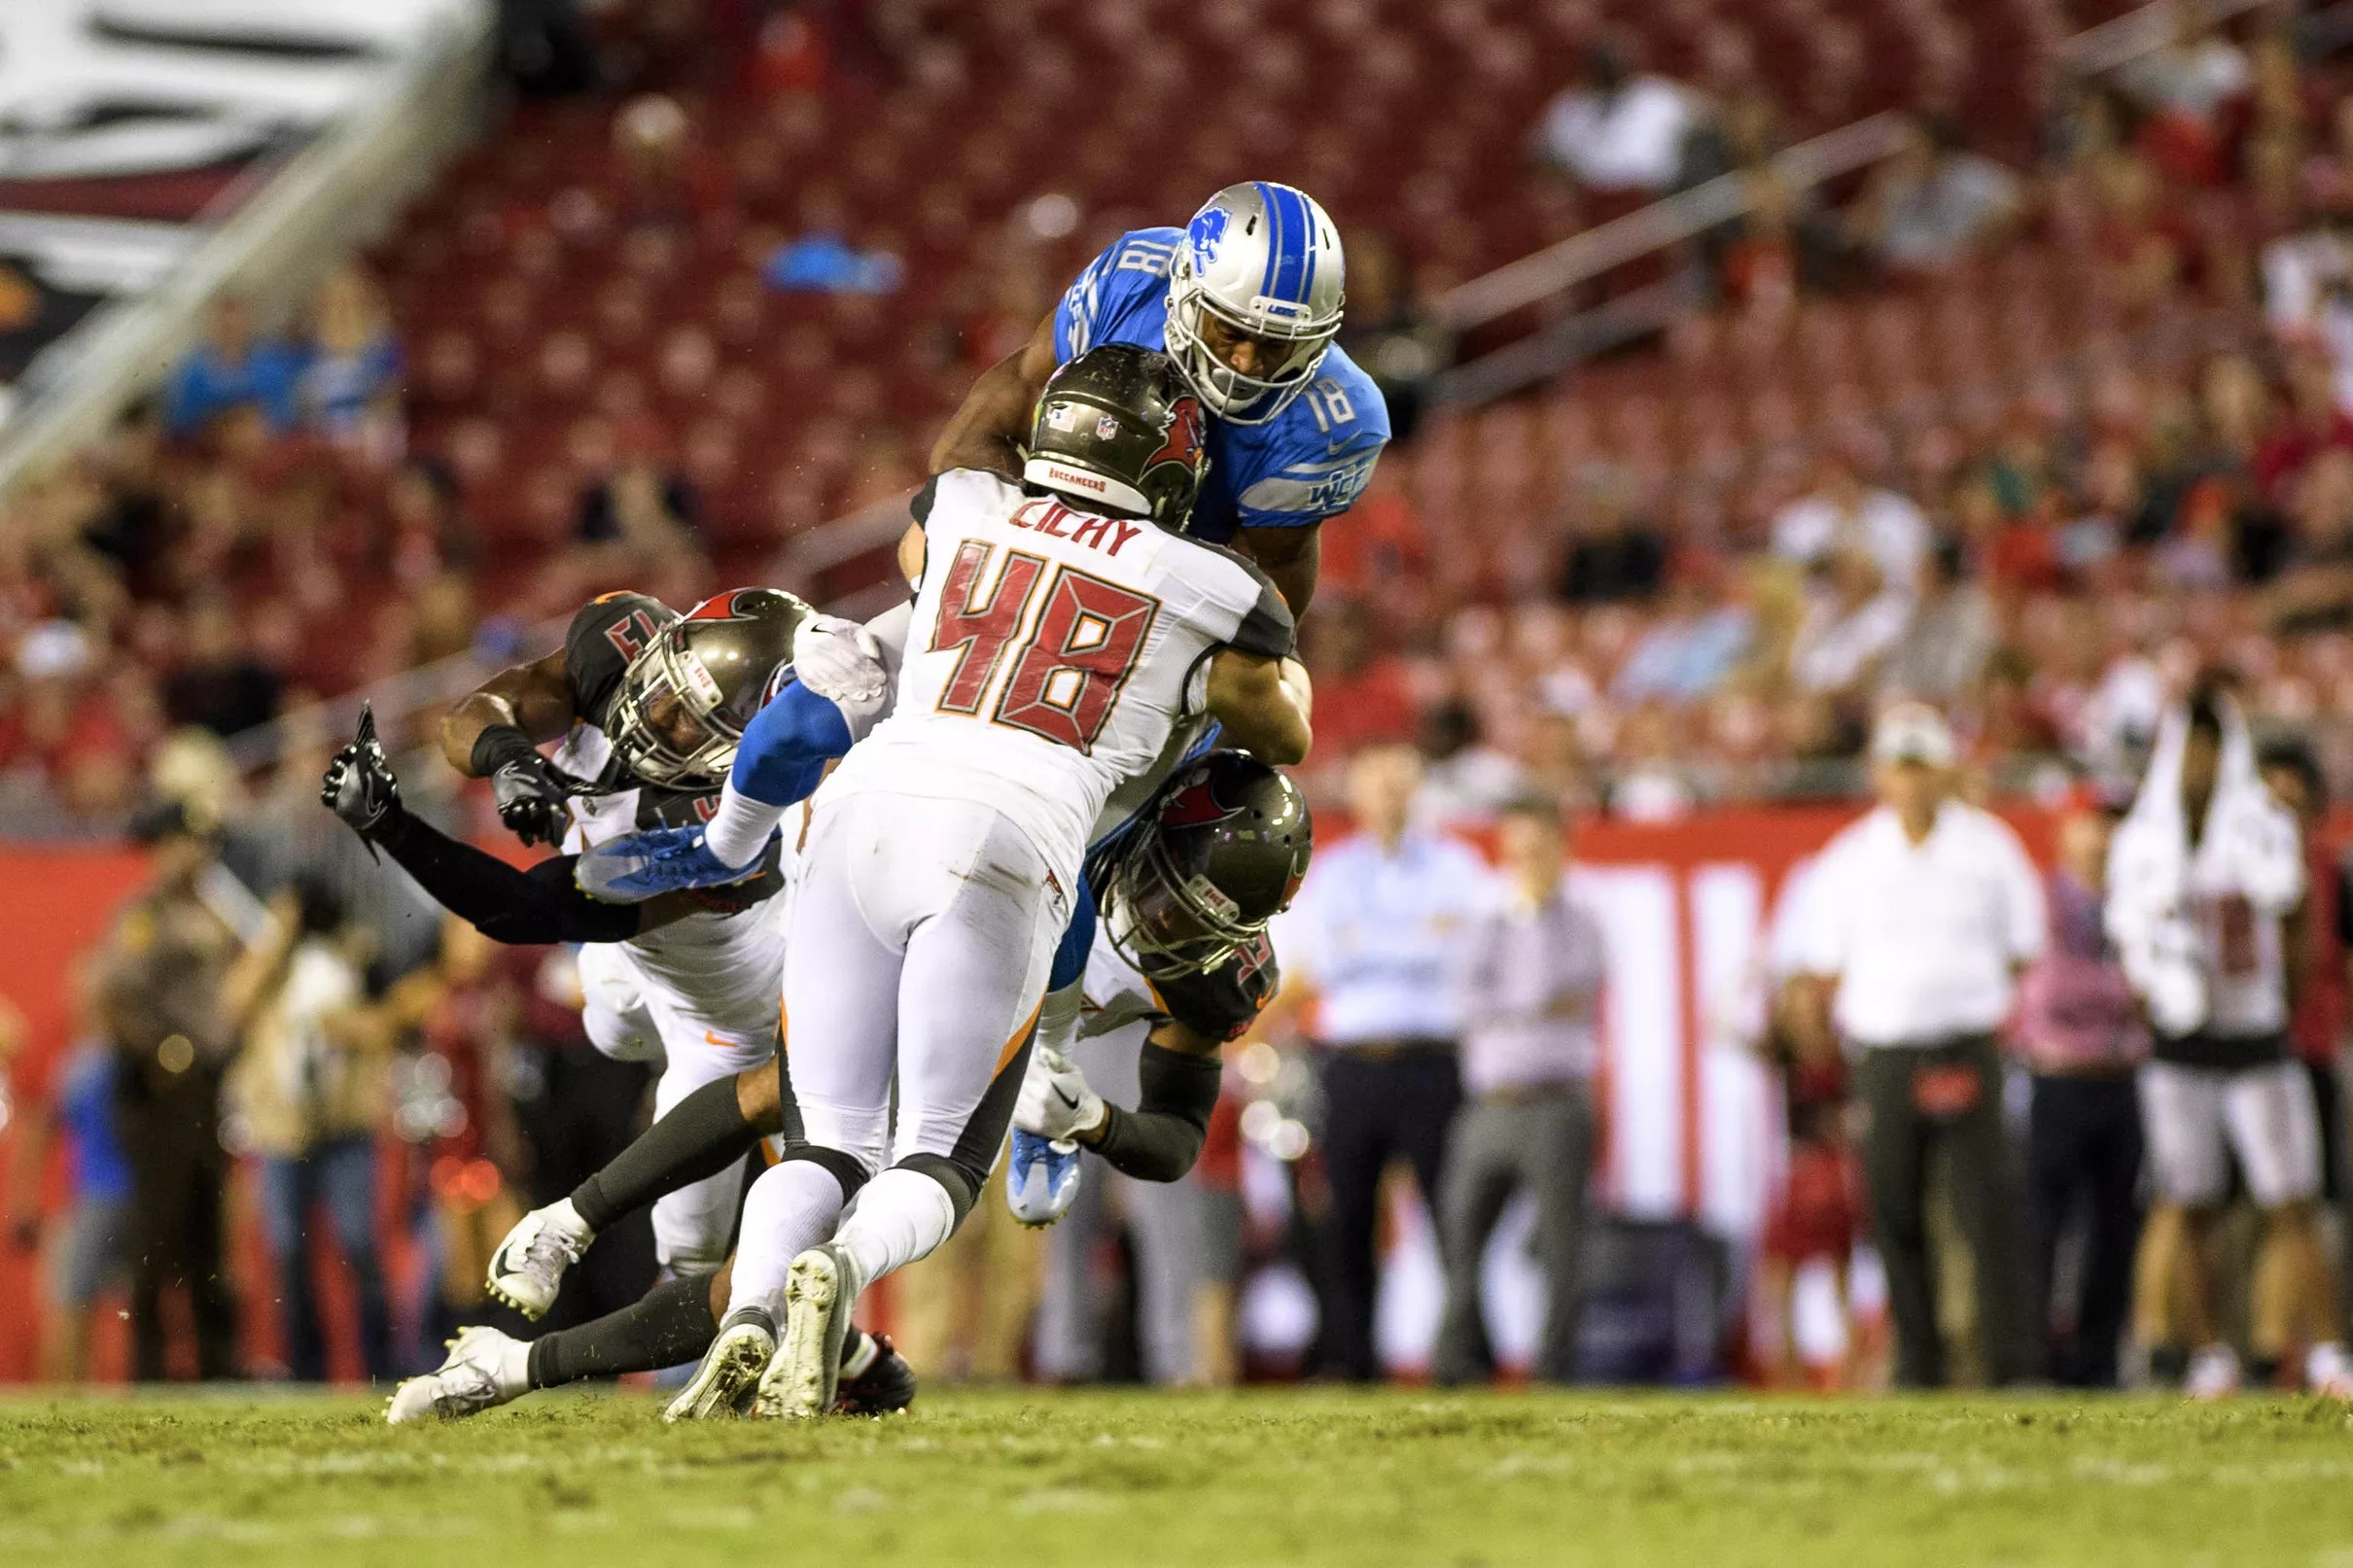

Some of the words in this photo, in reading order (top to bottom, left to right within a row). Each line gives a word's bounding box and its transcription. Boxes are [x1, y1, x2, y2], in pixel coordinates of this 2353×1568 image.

[1302, 376, 1357, 434] 18
[1049, 468, 1106, 493] BUCCANEERS
[1008, 500, 1143, 558] CICHY
[926, 537, 1163, 757] 48
